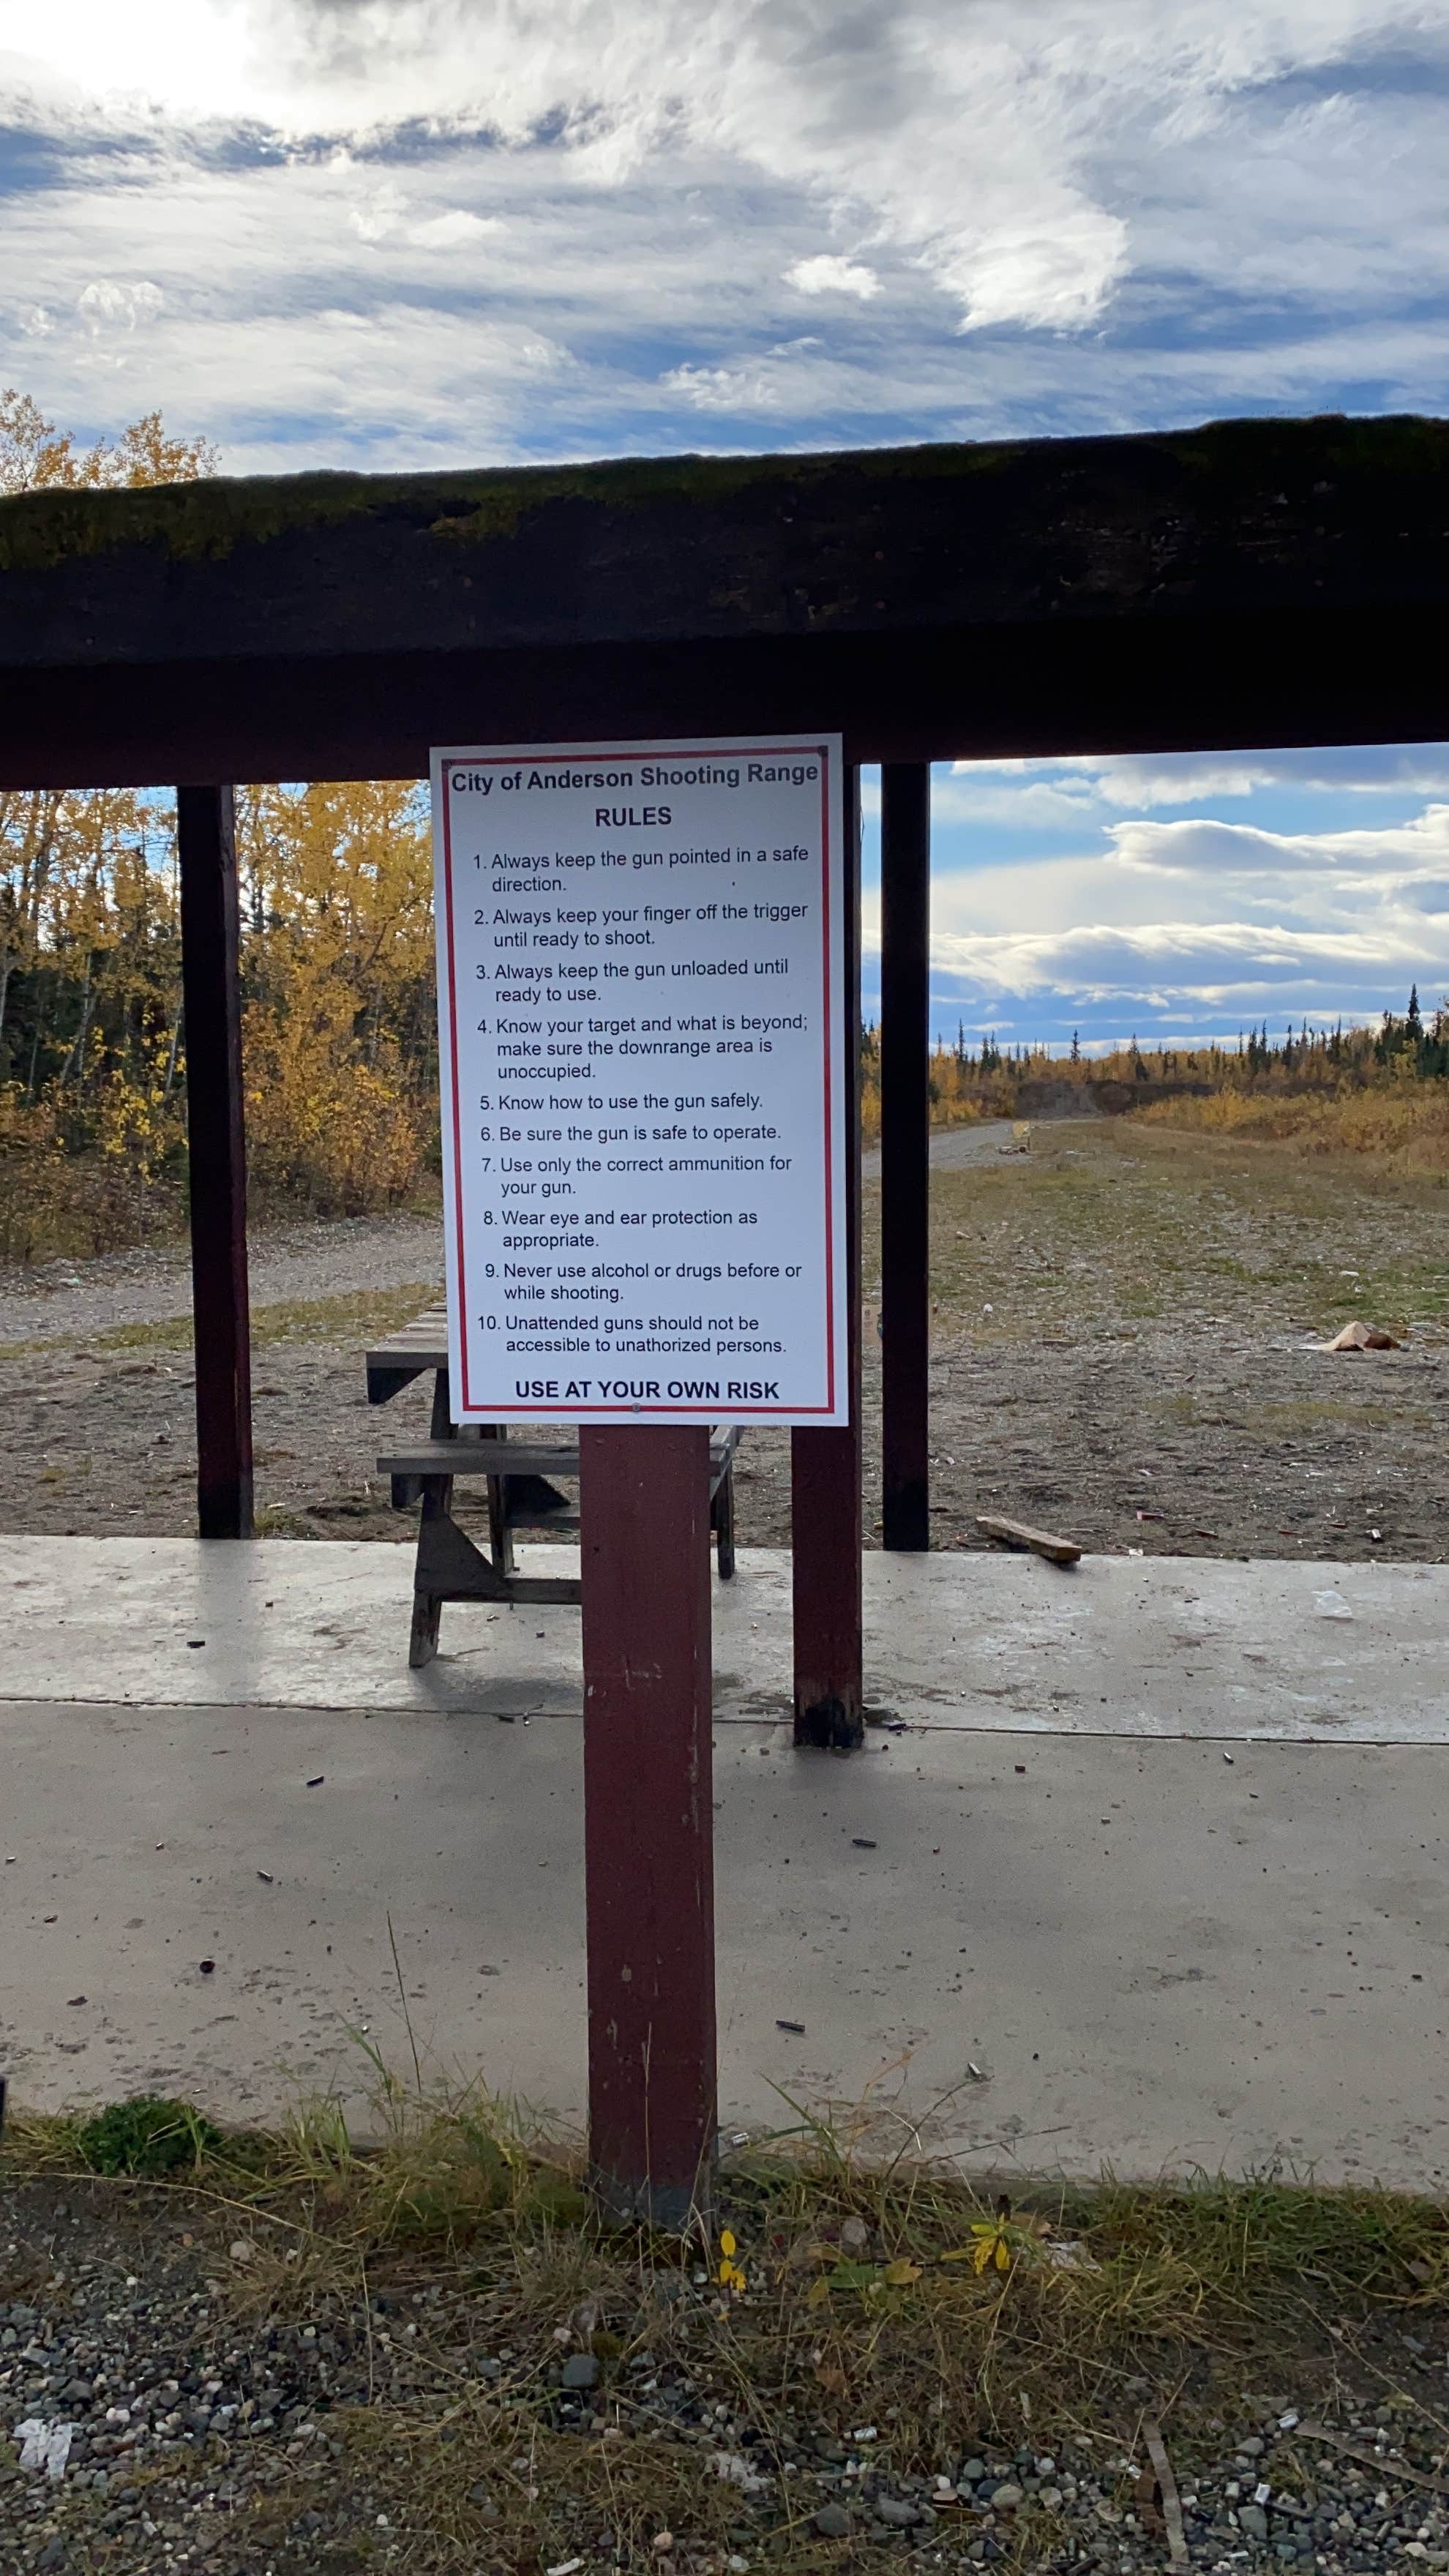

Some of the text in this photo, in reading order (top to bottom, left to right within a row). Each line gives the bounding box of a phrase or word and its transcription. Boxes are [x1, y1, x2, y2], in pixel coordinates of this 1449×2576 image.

[452, 764, 817, 795] City of Anderson Shooting Range
[596, 806, 671, 826] RULES
[474, 845, 808, 872] 1. Always keep the gun pointed in a safe
[493, 877, 566, 891] direction.
[475, 903, 808, 927] 2. Always keep your finger off the trigger
[495, 929, 654, 949] until ready to shoot.
[476, 959, 787, 982] 3. Always keep the gun unloaded until
[496, 986, 601, 1005] ready to use.
[477, 1014, 806, 1036] 4. Know your target and what is beyond;
[498, 1038, 772, 1057] make sure the downrange area is
[498, 1063, 595, 1082] unoccupied.
[480, 1093, 762, 1112] 5. Know how to use the gun safely.
[481, 1125, 781, 1144] 6. Be sure the gun is safe to operate.
[482, 1156, 792, 1175] 7. Use only the correct ammunition for
[501, 1183, 576, 1198] your gun.
[484, 1210, 757, 1228] 8. Wear eye and ear protection as
[503, 1232, 599, 1251] appropriate.
[485, 1263, 802, 1281] 9. Never use alcohol or drugs before or
[504, 1285, 624, 1303] while shooting.
[478, 1315, 759, 1333] 10. Unattended guns should not be
[506, 1337, 786, 1355] accessible to unathorized persons.
[516, 1381, 779, 1399] USE AT YOUR OWN RISK
